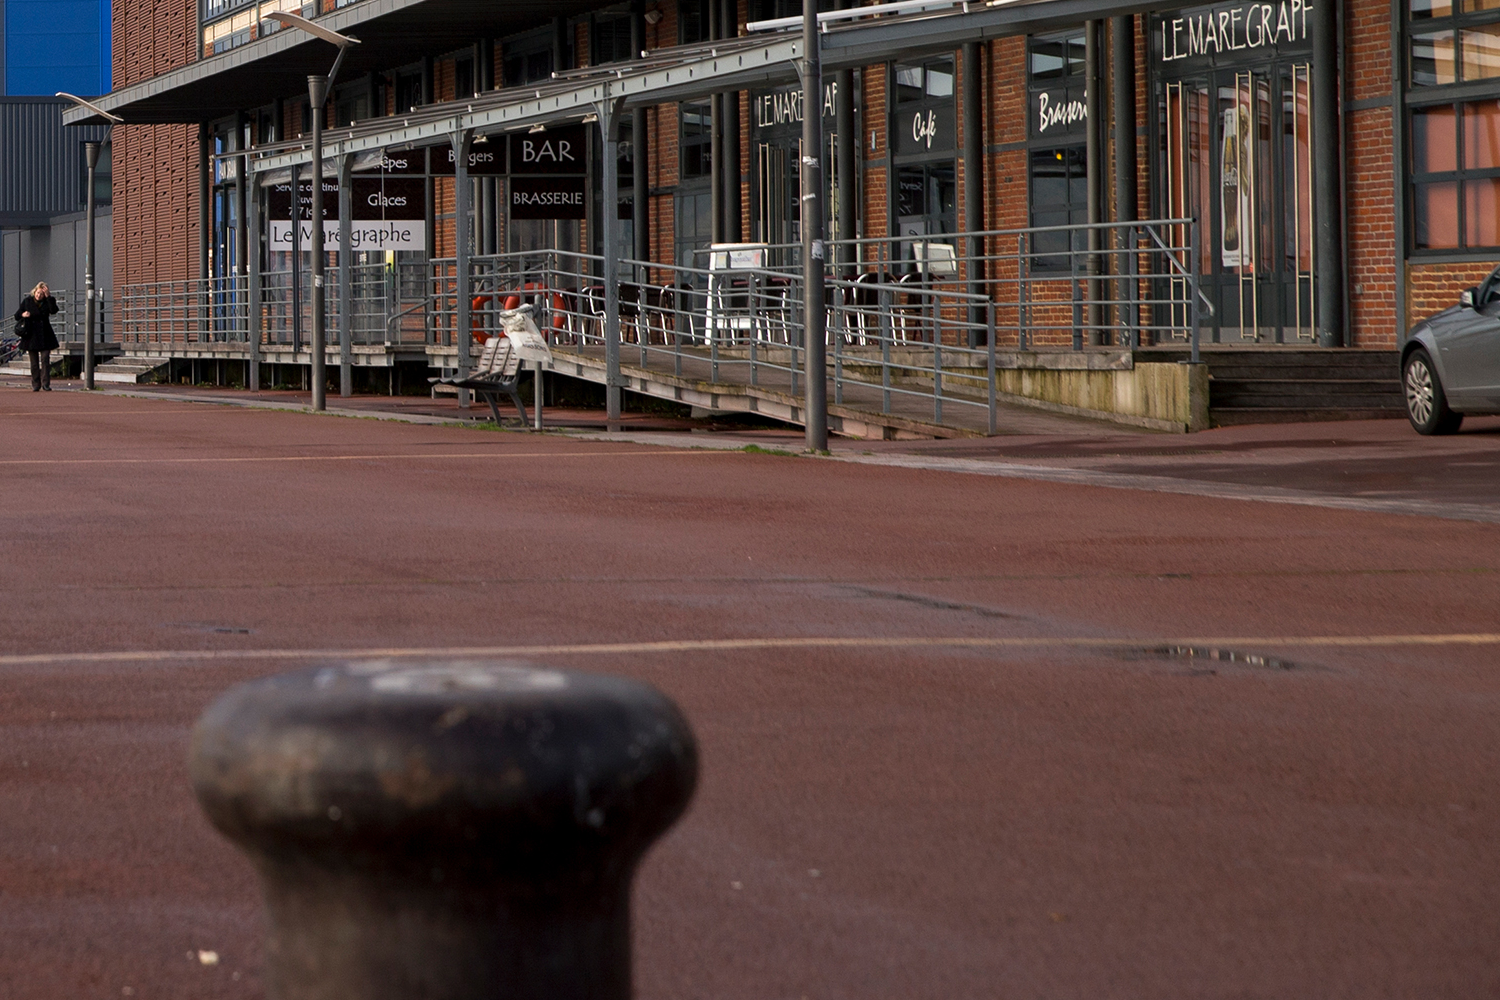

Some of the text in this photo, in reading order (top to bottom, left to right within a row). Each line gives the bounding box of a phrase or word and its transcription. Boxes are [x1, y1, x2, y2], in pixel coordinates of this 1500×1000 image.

[1039, 90, 1088, 132] Brasseri
[912, 109, 937, 149] Café
[448, 150, 494, 166] Bgers
[523, 140, 575, 162] BAR
[374, 155, 408, 172] êpes
[367, 191, 407, 207] Glaces
[513, 192, 583, 205] BRASSERIE
[273, 226, 293, 243] Le
